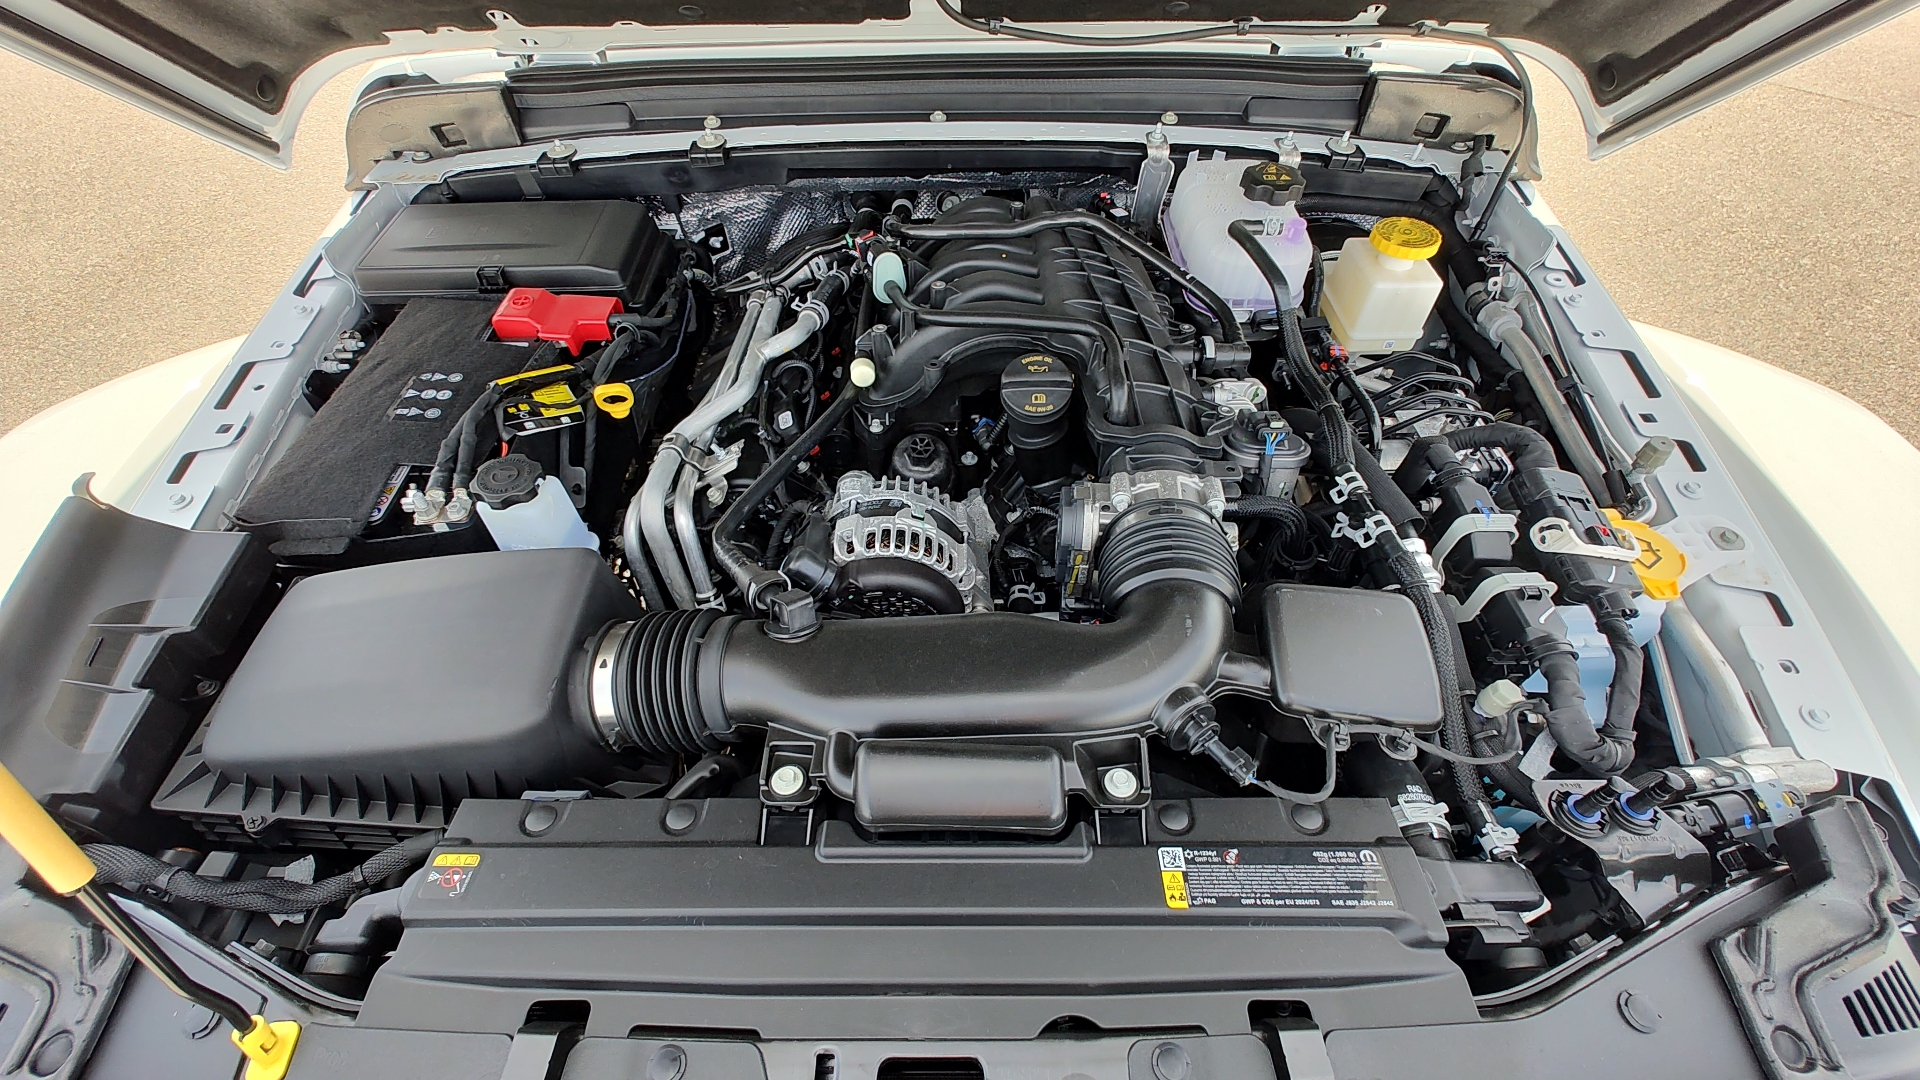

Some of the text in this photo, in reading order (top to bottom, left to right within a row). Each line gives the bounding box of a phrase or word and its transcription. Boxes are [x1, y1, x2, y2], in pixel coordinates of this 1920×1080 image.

[1021, 356, 1053, 364] ENGINE OIL
[1406, 784, 1423, 793] RAD
